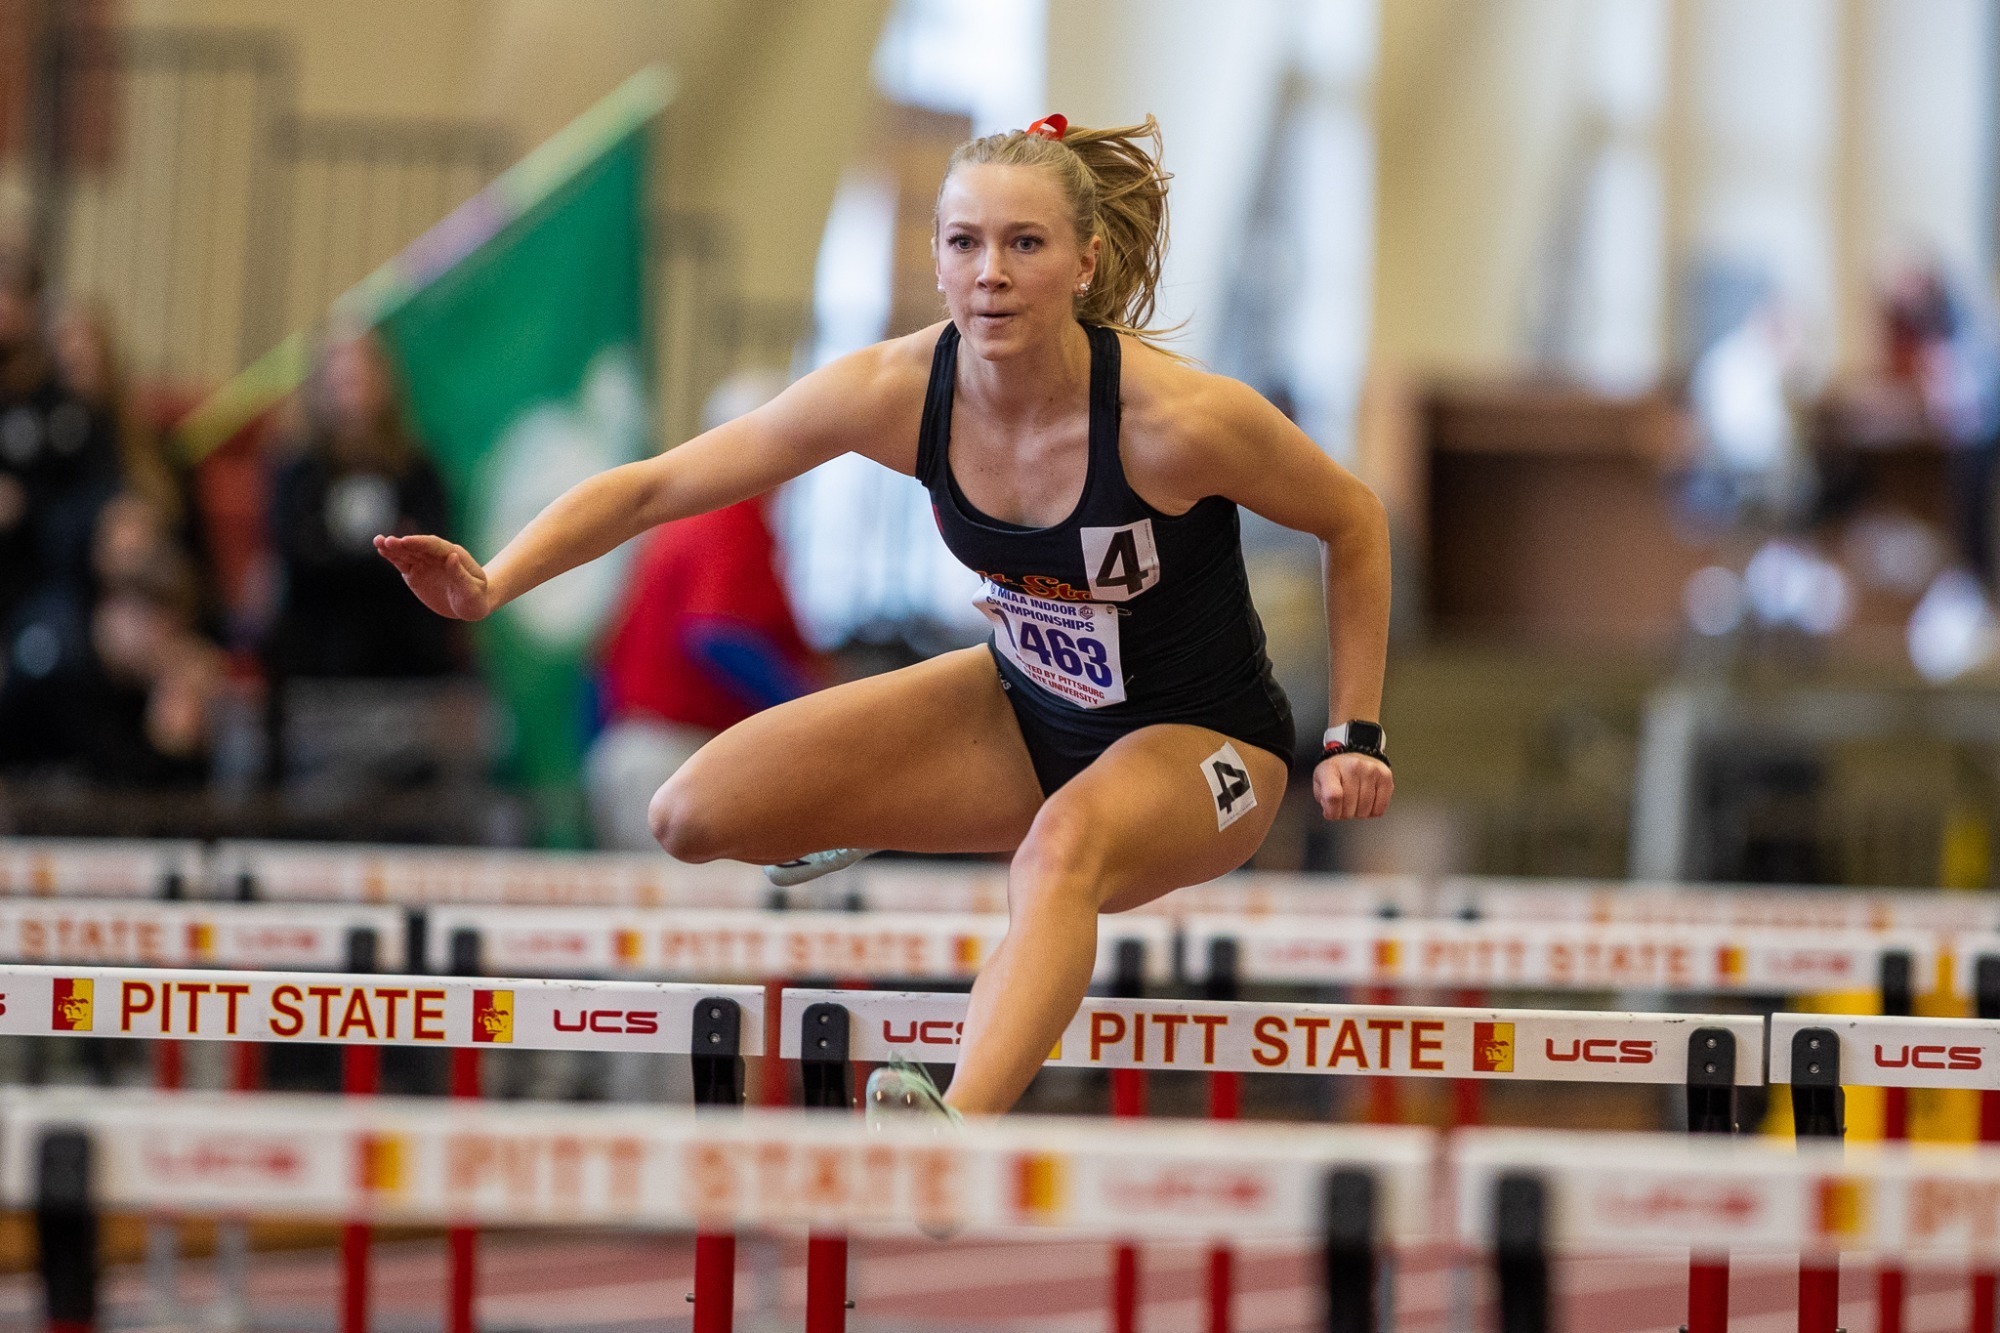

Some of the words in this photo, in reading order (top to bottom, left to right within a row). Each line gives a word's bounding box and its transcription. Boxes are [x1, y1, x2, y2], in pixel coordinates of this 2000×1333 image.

[1095, 528, 1149, 595] 4
[998, 587, 1028, 605] MIAA
[1030, 597, 1076, 616] INDOOR
[1043, 670, 1056, 680] BY
[1058, 674, 1105, 699] PITTSBURG
[1048, 680, 1098, 705] UNIVERSITY
[1212, 760, 1251, 815] 4
[120, 981, 251, 1034] PITT
[268, 985, 447, 1041] STATE
[553, 1008, 659, 1034] UCS
[1090, 1011, 1229, 1064] PITT
[1251, 1015, 1446, 1071] STATE
[1545, 1037, 1654, 1064] UCS
[1874, 1043, 1983, 1071] UCS
